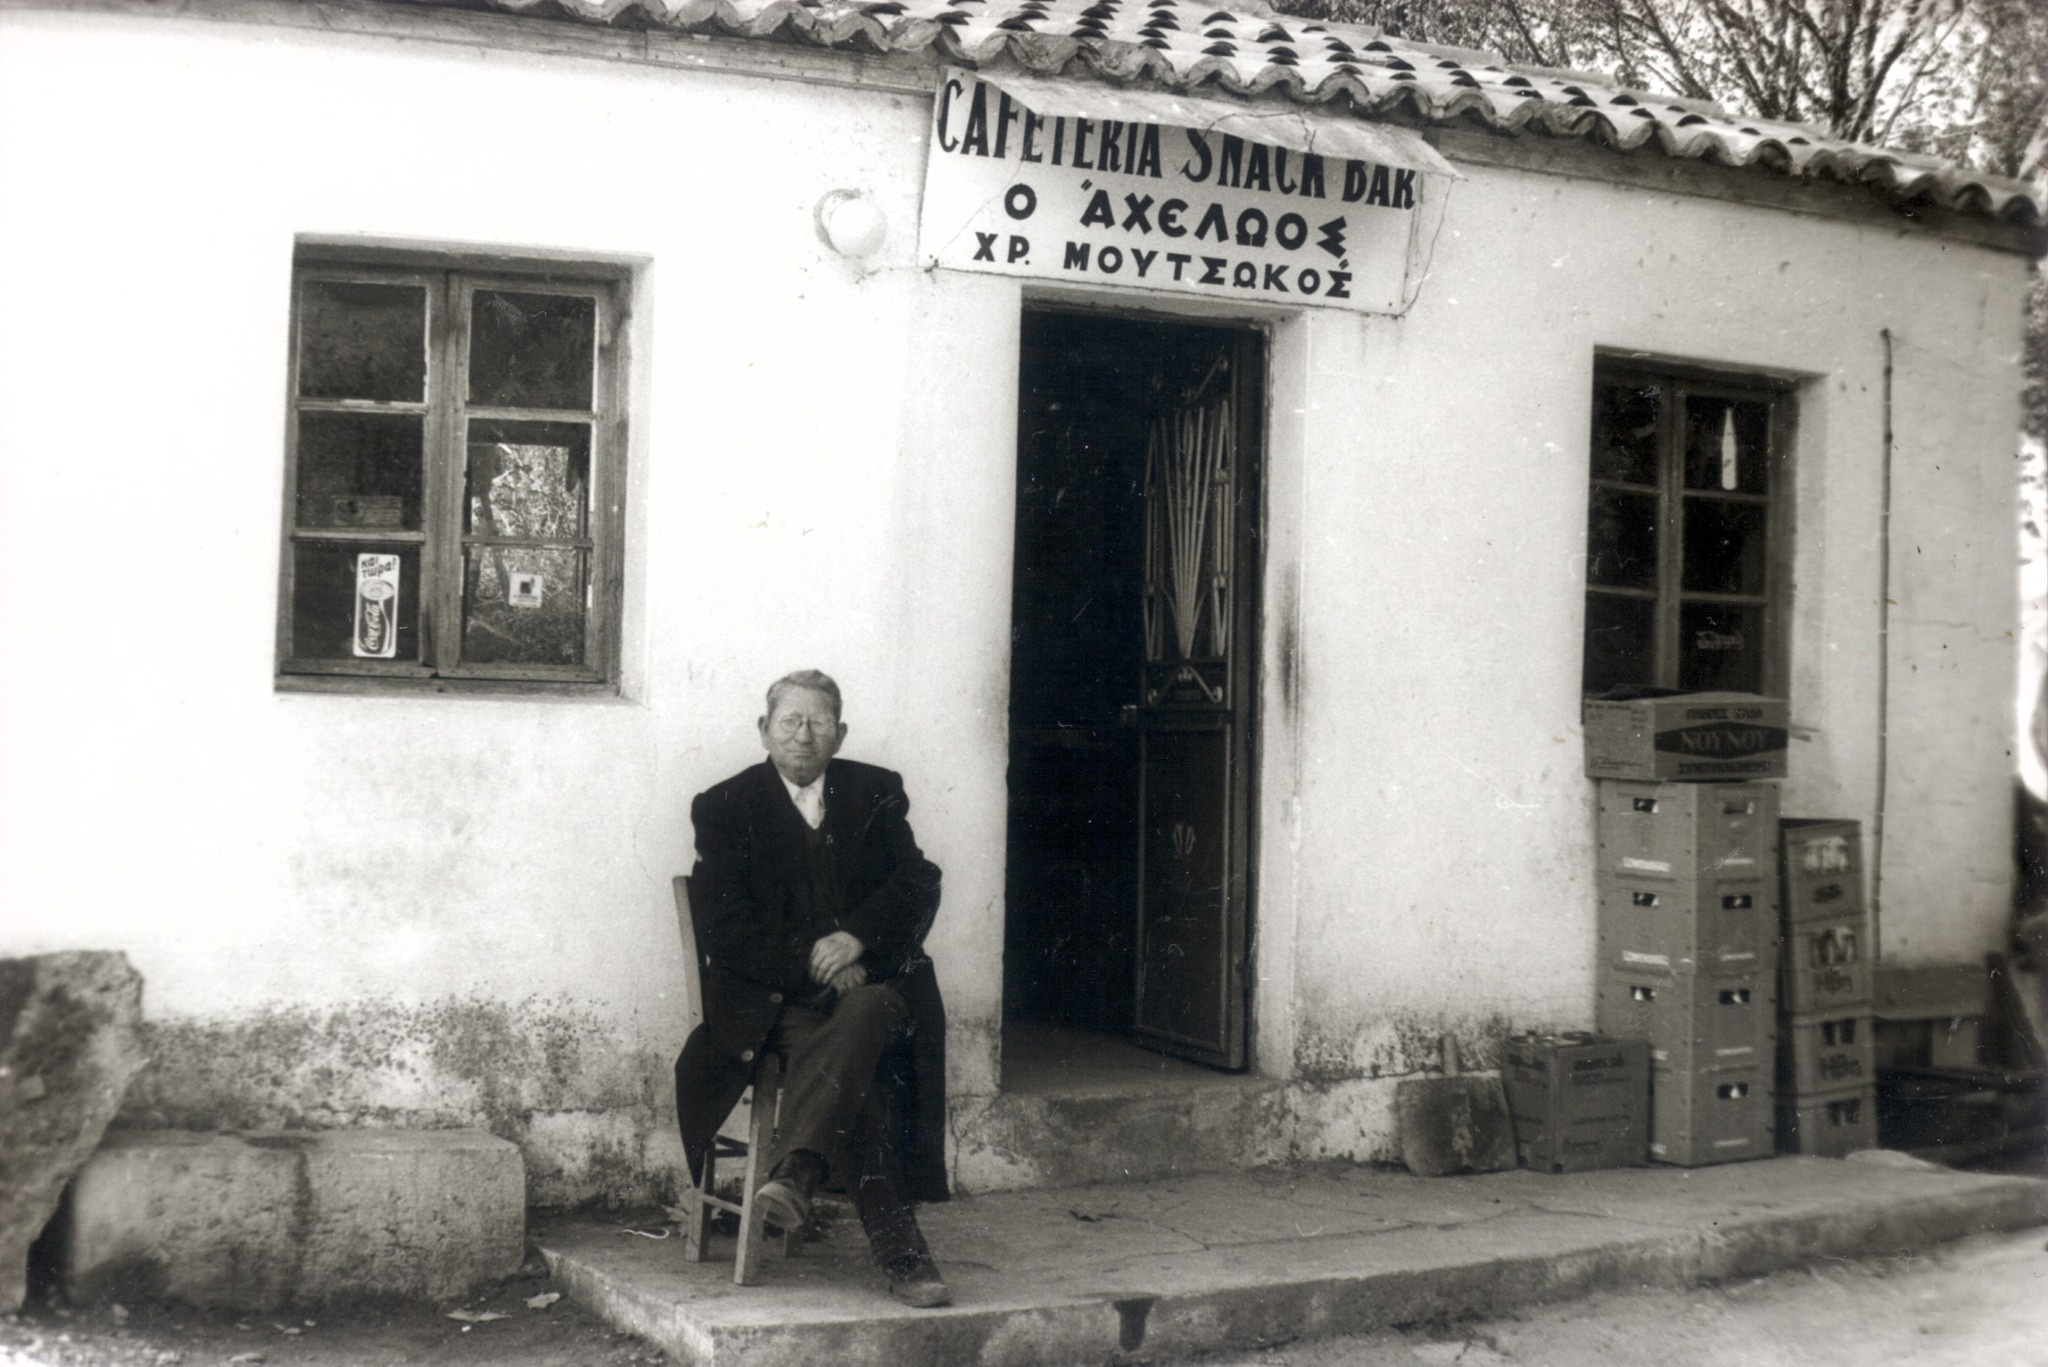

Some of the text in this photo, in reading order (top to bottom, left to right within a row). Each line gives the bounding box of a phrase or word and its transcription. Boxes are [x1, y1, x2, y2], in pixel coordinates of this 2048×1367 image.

[937, 78, 1162, 178] CAFETERIA
[1180, 127, 1326, 198] SNACK
[1004, 183, 1037, 220] Ο
[973, 231, 1352, 298] ΧΡ. ΜΟΥΤΣΩΚΟΣ
